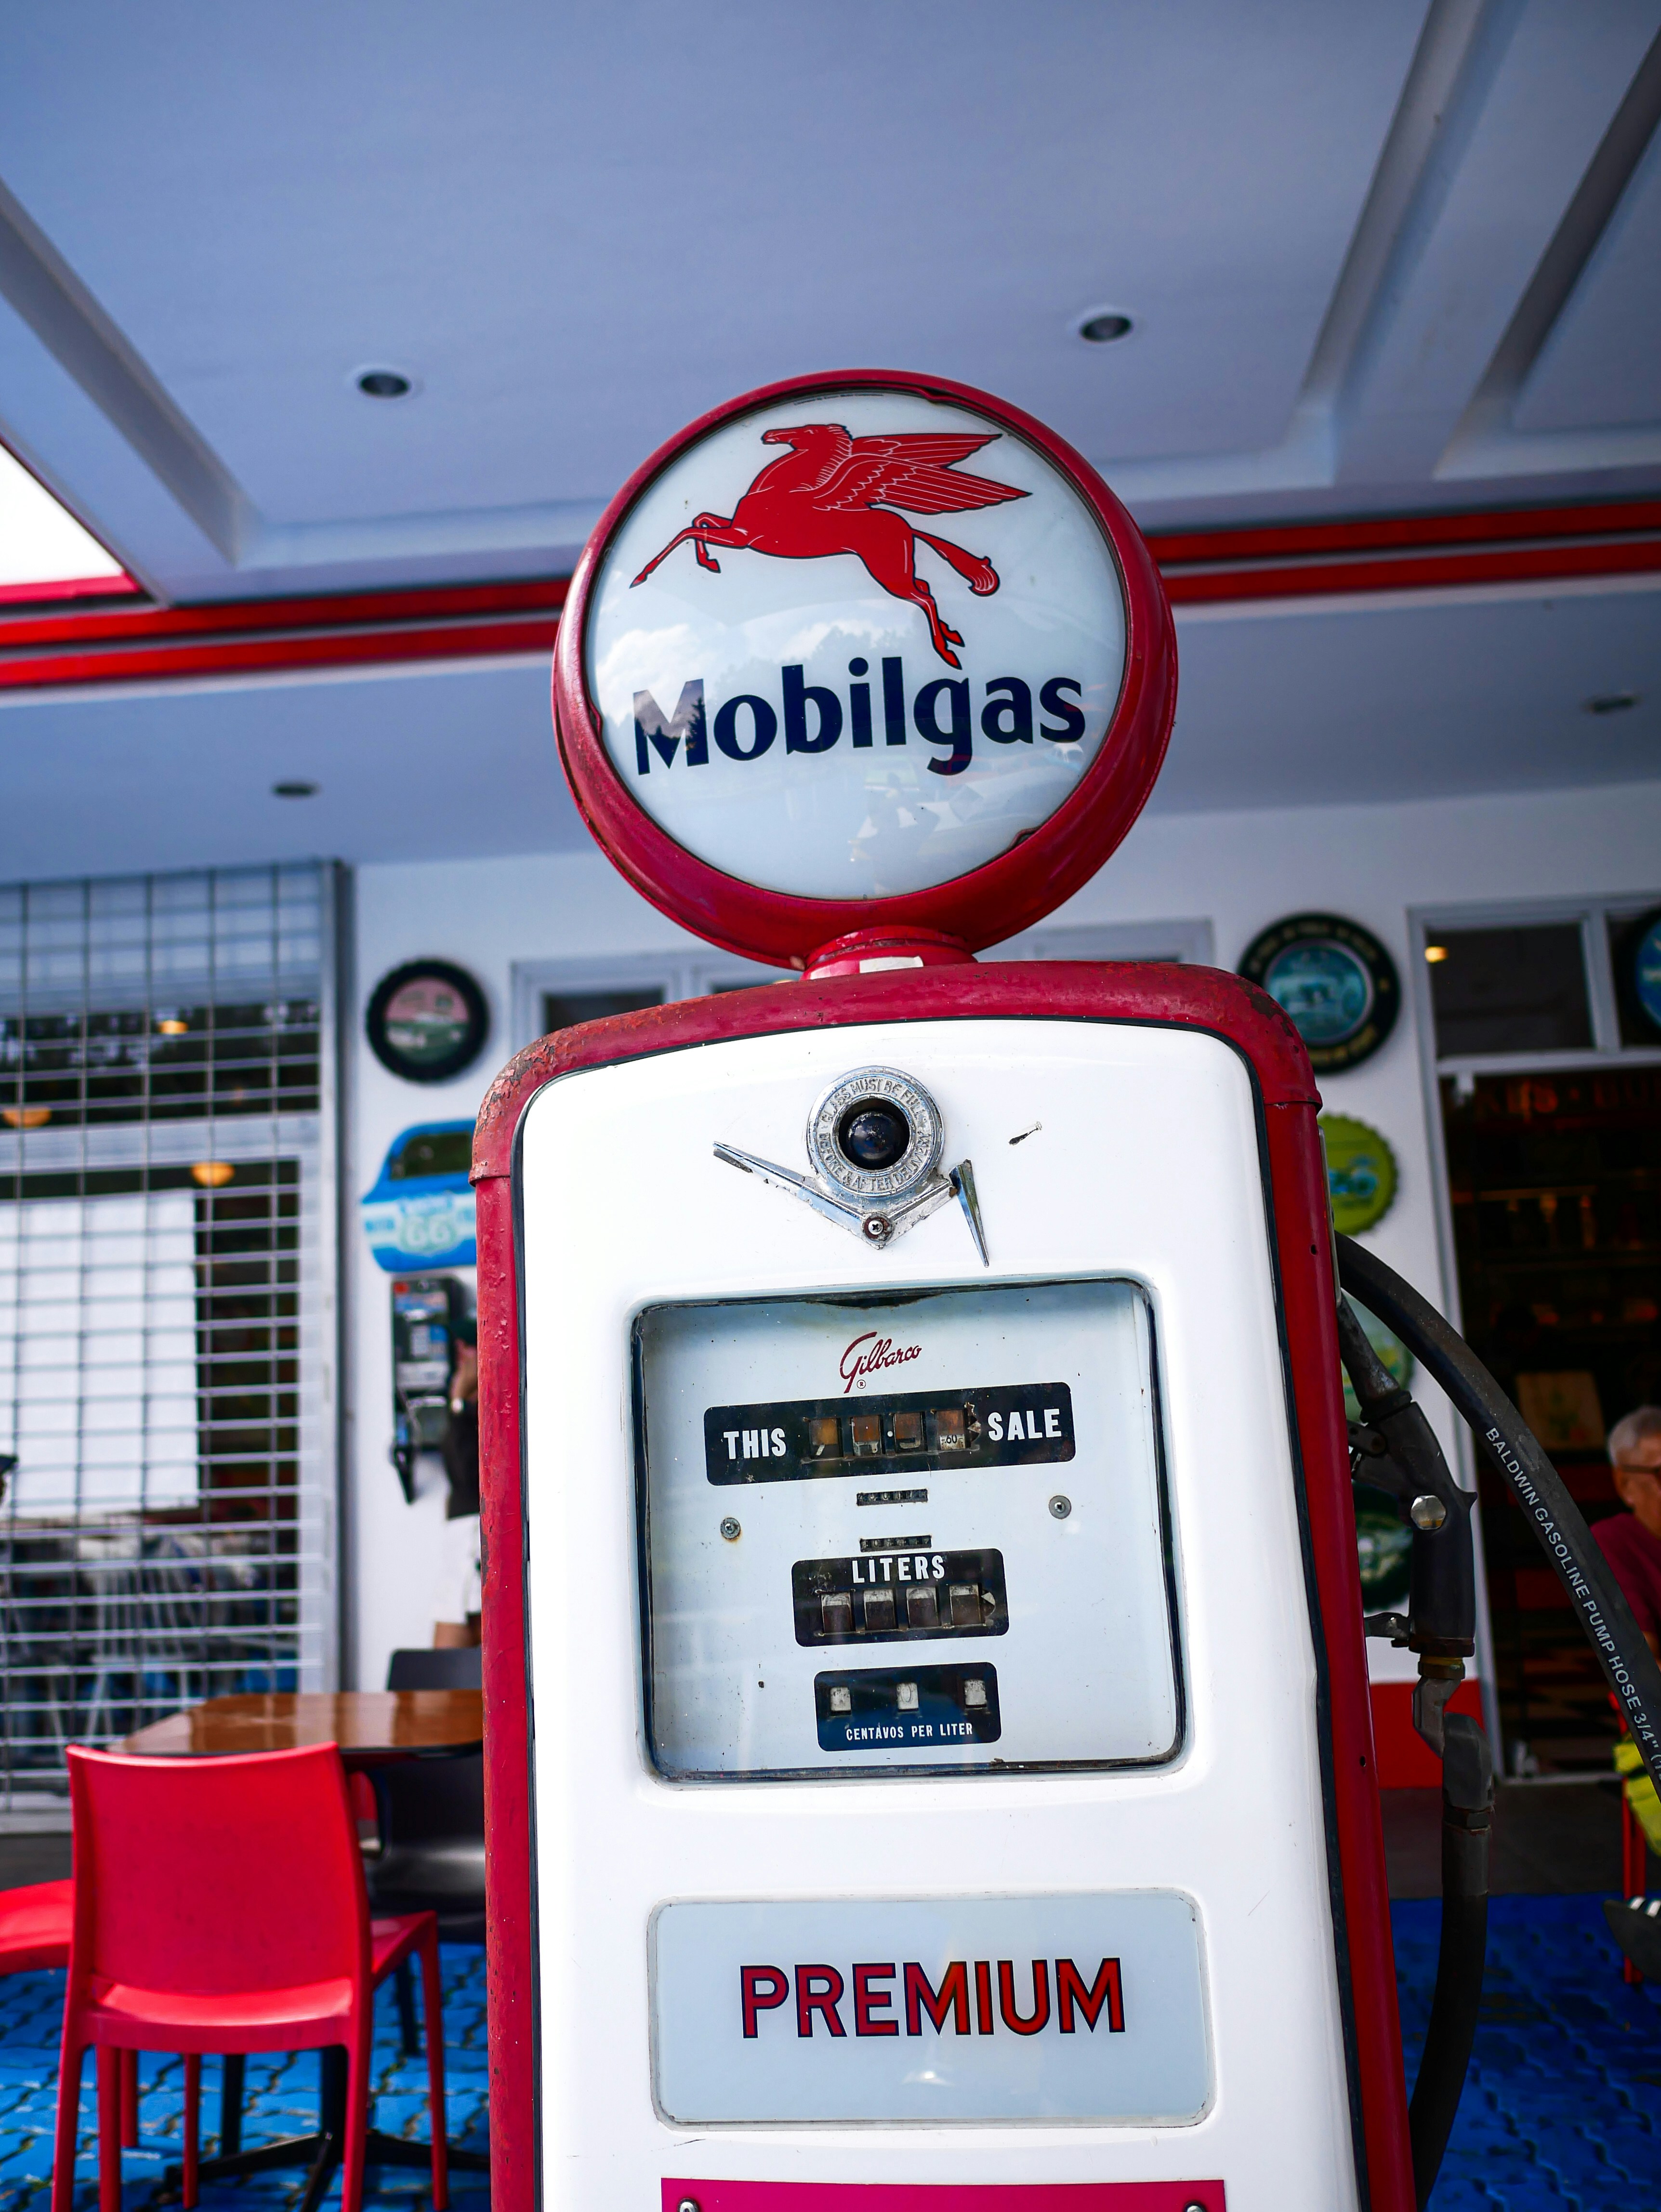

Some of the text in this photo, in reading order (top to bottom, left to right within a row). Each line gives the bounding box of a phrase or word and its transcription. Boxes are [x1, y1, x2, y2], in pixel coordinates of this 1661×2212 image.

[633, 656, 1086, 775] Mobilgas
[820, 1078, 925, 1122] GLASS MUST BE FULL
[818, 1132, 846, 1177] BEFORE
[852, 1176, 893, 1191] AFTER
[892, 1131, 931, 1185] DELIVERY
[840, 1331, 922, 1394] Gilbarco
[724, 1428, 786, 1459] THIS
[988, 1409, 1062, 1441] SALE
[852, 1555, 945, 1583] LITERS
[1486, 1427, 1540, 1506] BALDWIN
[1535, 1507, 1590, 1599] GASOLINE
[1583, 1600, 1616, 1652] PUMP
[1608, 1656, 1642, 1710] HOSE
[1634, 1713, 1659, 1749] 3/4"
[911, 1725, 933, 1738] PER
[940, 1723, 973, 1736] LITER
[740, 1957, 1125, 2039] PREMIUM
